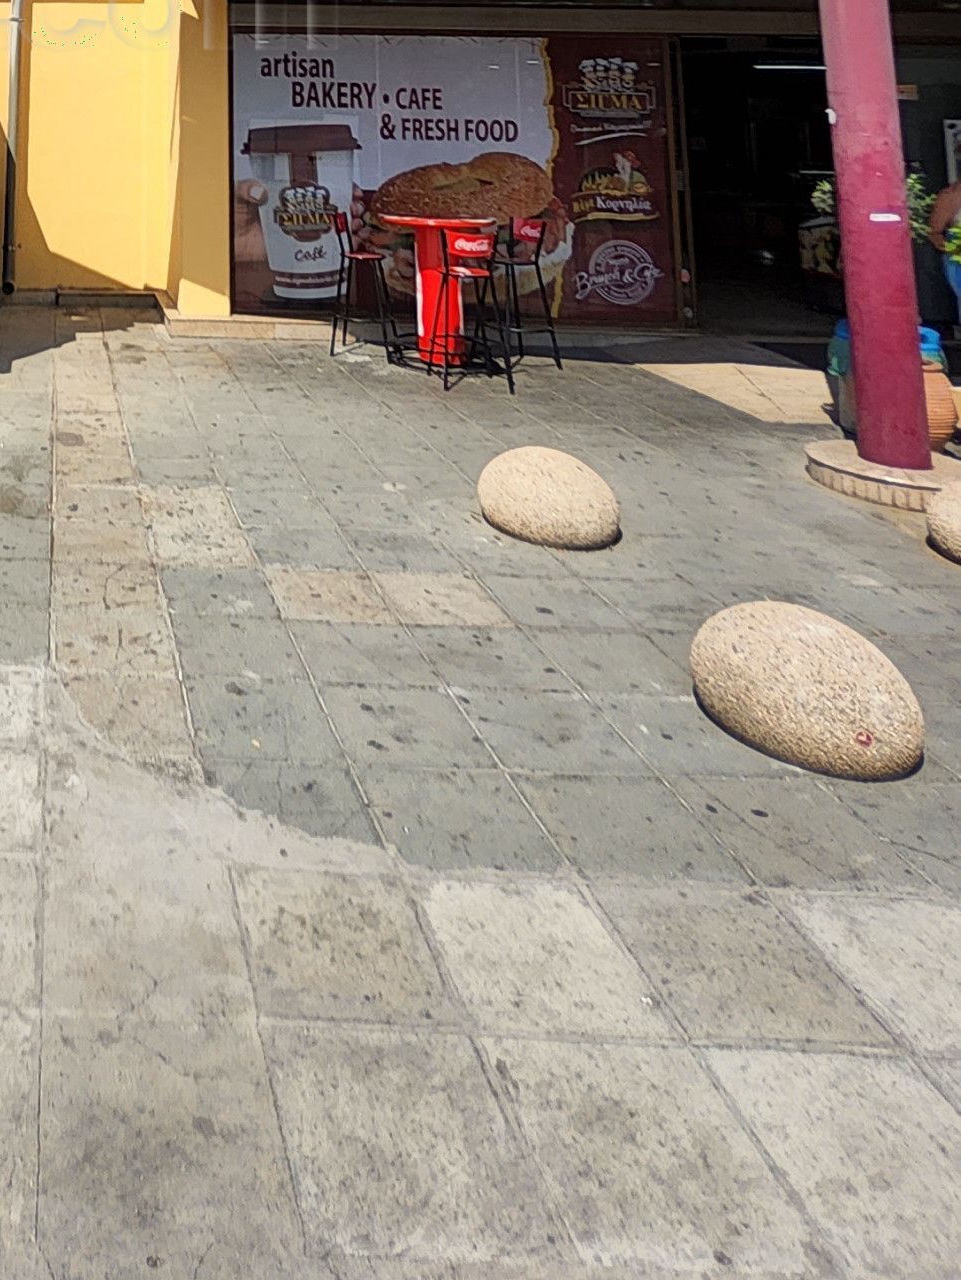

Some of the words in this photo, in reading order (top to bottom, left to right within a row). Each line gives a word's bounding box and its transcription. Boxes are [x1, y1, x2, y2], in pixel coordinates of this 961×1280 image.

[260, 51, 335, 79] artisan
[291, 81, 377, 110] BAKERY
[395, 88, 442, 111] CAFE
[380, 113, 396, 139] &
[401, 118, 459, 142] FRESH
[464, 119, 518, 143] FOOD
